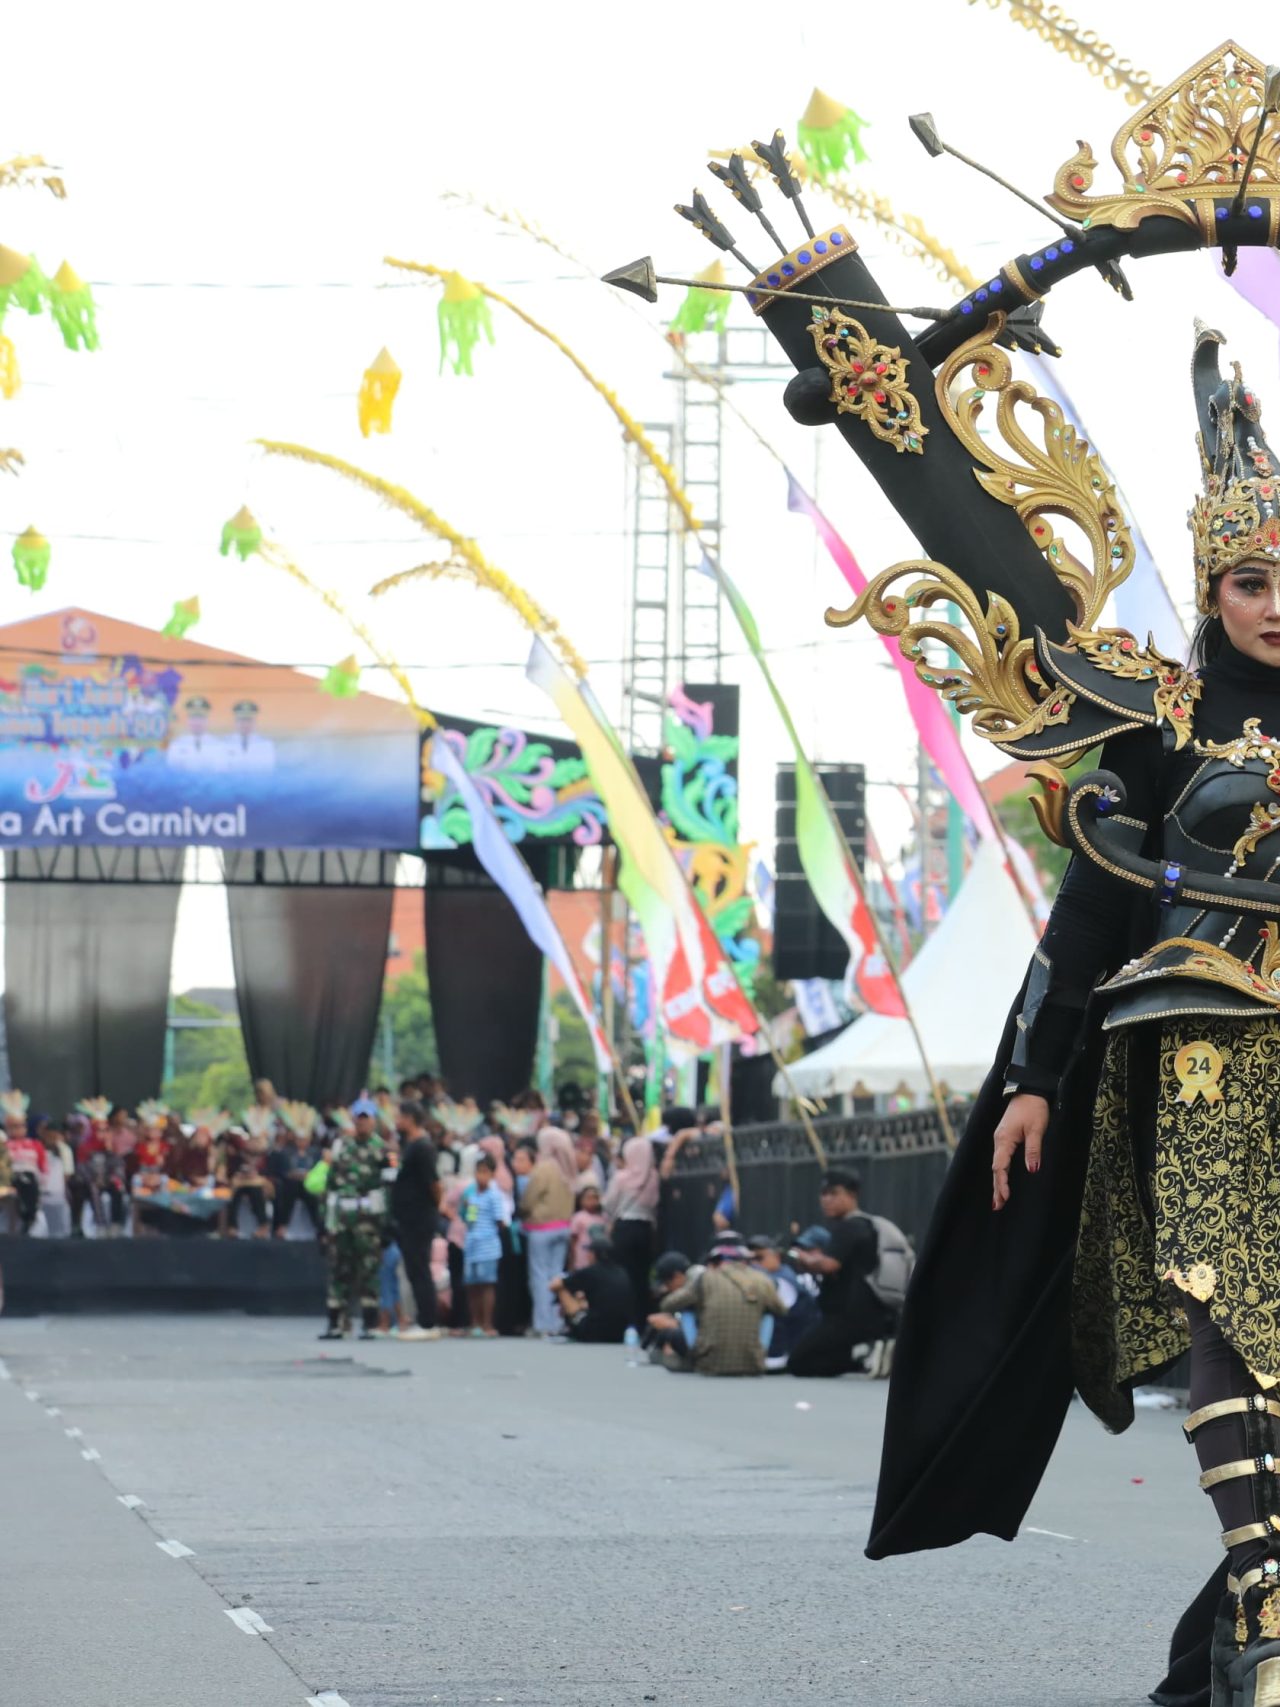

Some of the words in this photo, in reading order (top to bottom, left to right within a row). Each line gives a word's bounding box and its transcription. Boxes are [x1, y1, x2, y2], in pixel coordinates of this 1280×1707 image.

[32, 804, 84, 837] Art
[95, 803, 246, 837] Carnival
[1186, 1056, 1211, 1075] 24
